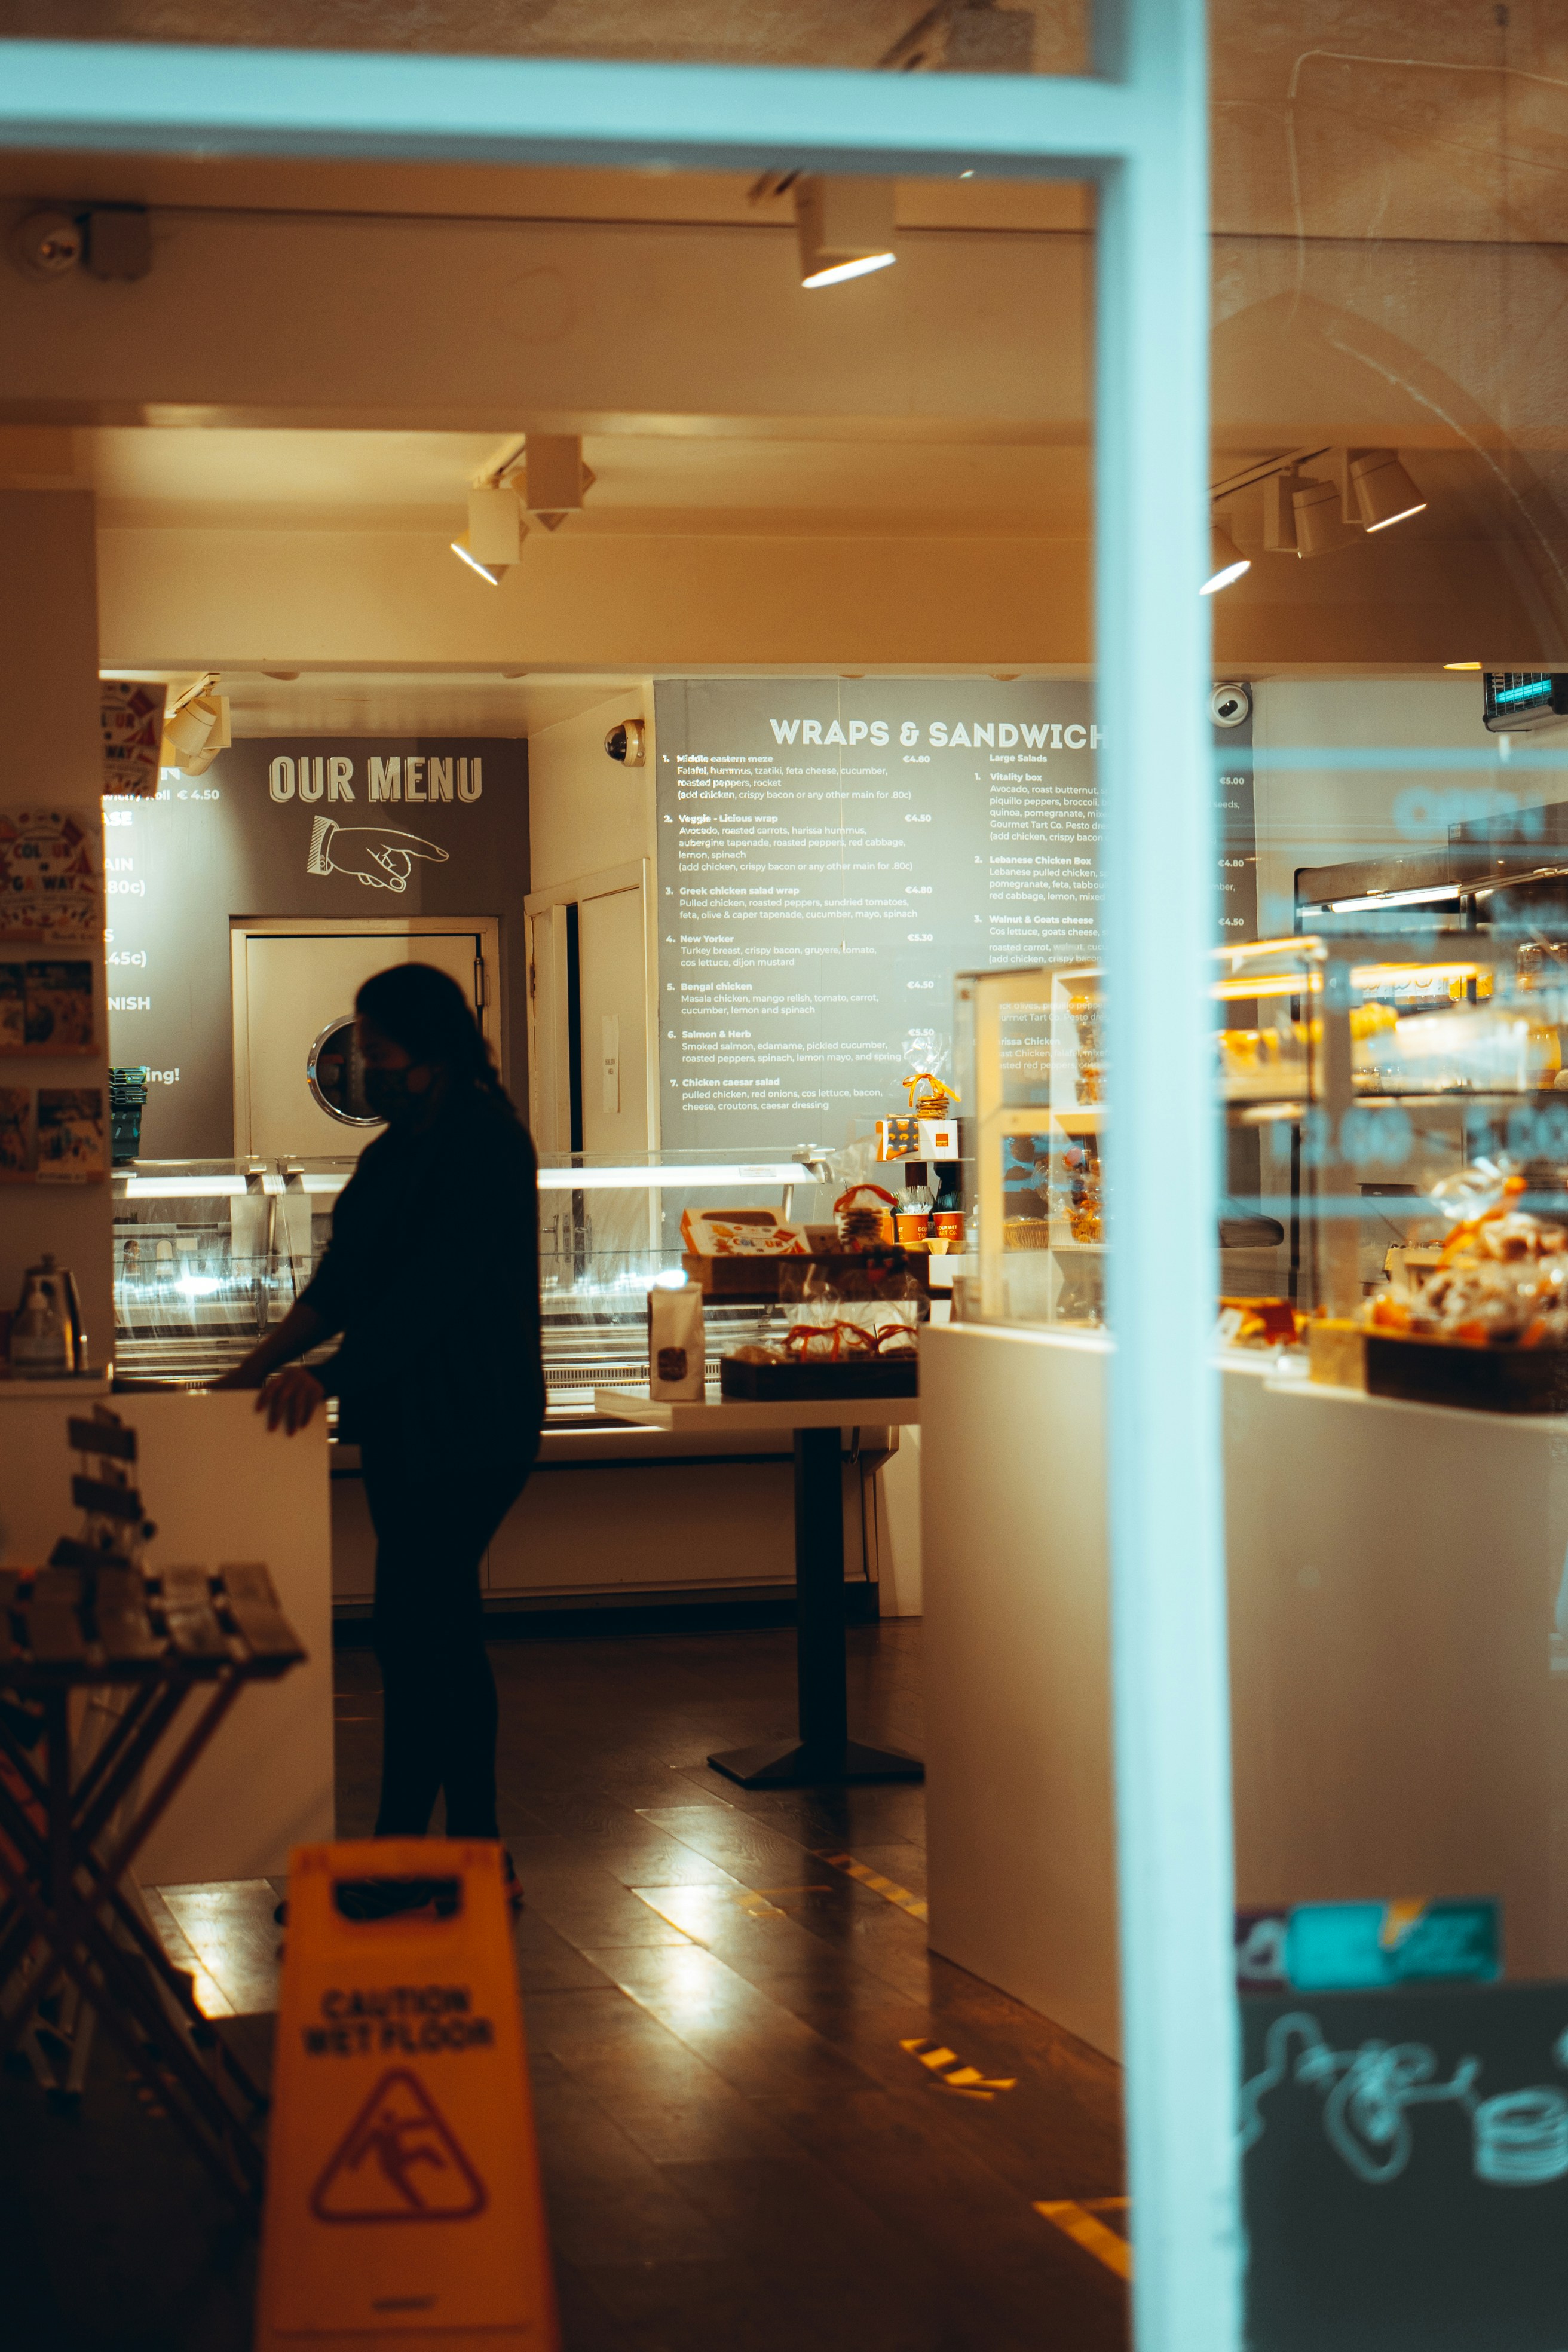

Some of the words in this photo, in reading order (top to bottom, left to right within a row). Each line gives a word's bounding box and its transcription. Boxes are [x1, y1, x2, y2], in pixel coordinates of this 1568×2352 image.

[770, 719, 889, 746] WRAPS
[899, 721, 920, 747] &
[929, 722, 1109, 749] SANDWICH
[990, 754, 1015, 763] Large
[1018, 754, 1047, 762] Salads
[270, 755, 355, 803] OUR
[368, 755, 483, 803] MENU
[990, 773, 1023, 782] Vitality
[990, 785, 1029, 794] Avocado,
[177, 789, 188, 800] €
[191, 789, 219, 800] 4.50
[990, 797, 1022, 806] piquillo
[990, 808, 1022, 817] quinoa,
[679, 814, 711, 824] Veggie
[719, 814, 752, 822] Licious
[679, 826, 719, 835] Avocado,
[679, 839, 724, 848] aubergine
[727, 838, 771, 847] tapenade,
[865, 838, 905, 847] cabbage,
[679, 851, 709, 859] lemon,
[712, 851, 746, 860] spinach
[1035, 856, 1071, 864] Chicken
[1218, 859, 1244, 868] €4.80
[679, 863, 699, 872] (add
[702, 863, 737, 871] chicken,
[740, 863, 766, 872] crispy
[892, 862, 912, 871] .80c)
[1033, 869, 1060, 877] pulled
[1052, 880, 1071, 889] feta,
[710, 886, 746, 895] chicken
[1006, 892, 1045, 901] cabbage,
[1048, 892, 1077, 901] lemon,
[710, 899, 746, 907] chicken,
[679, 911, 699, 920] feta,
[760, 911, 804, 920] tapenade,
[884, 910, 917, 918] spinach
[698, 958, 731, 967] lettuce,
[733, 958, 755, 967] dijon
[681, 982, 713, 992] Bengal
[907, 981, 934, 989] €4.50
[714, 994, 750, 1003] chicken,
[108, 997, 151, 1010] NISH
[681, 1006, 728, 1015] cucumber,
[781, 1006, 815, 1015] spinach
[908, 1028, 935, 1037] €5.50
[721, 1042, 755, 1051] salmon,
[807, 1042, 838, 1051] pickled
[682, 1078, 720, 1087] Chicken
[792, 1101, 829, 1110] dressing
[321, 1985, 471, 2021] CAUTION
[304, 2024, 371, 2058] WET
[379, 2017, 494, 2056] FLOOR
